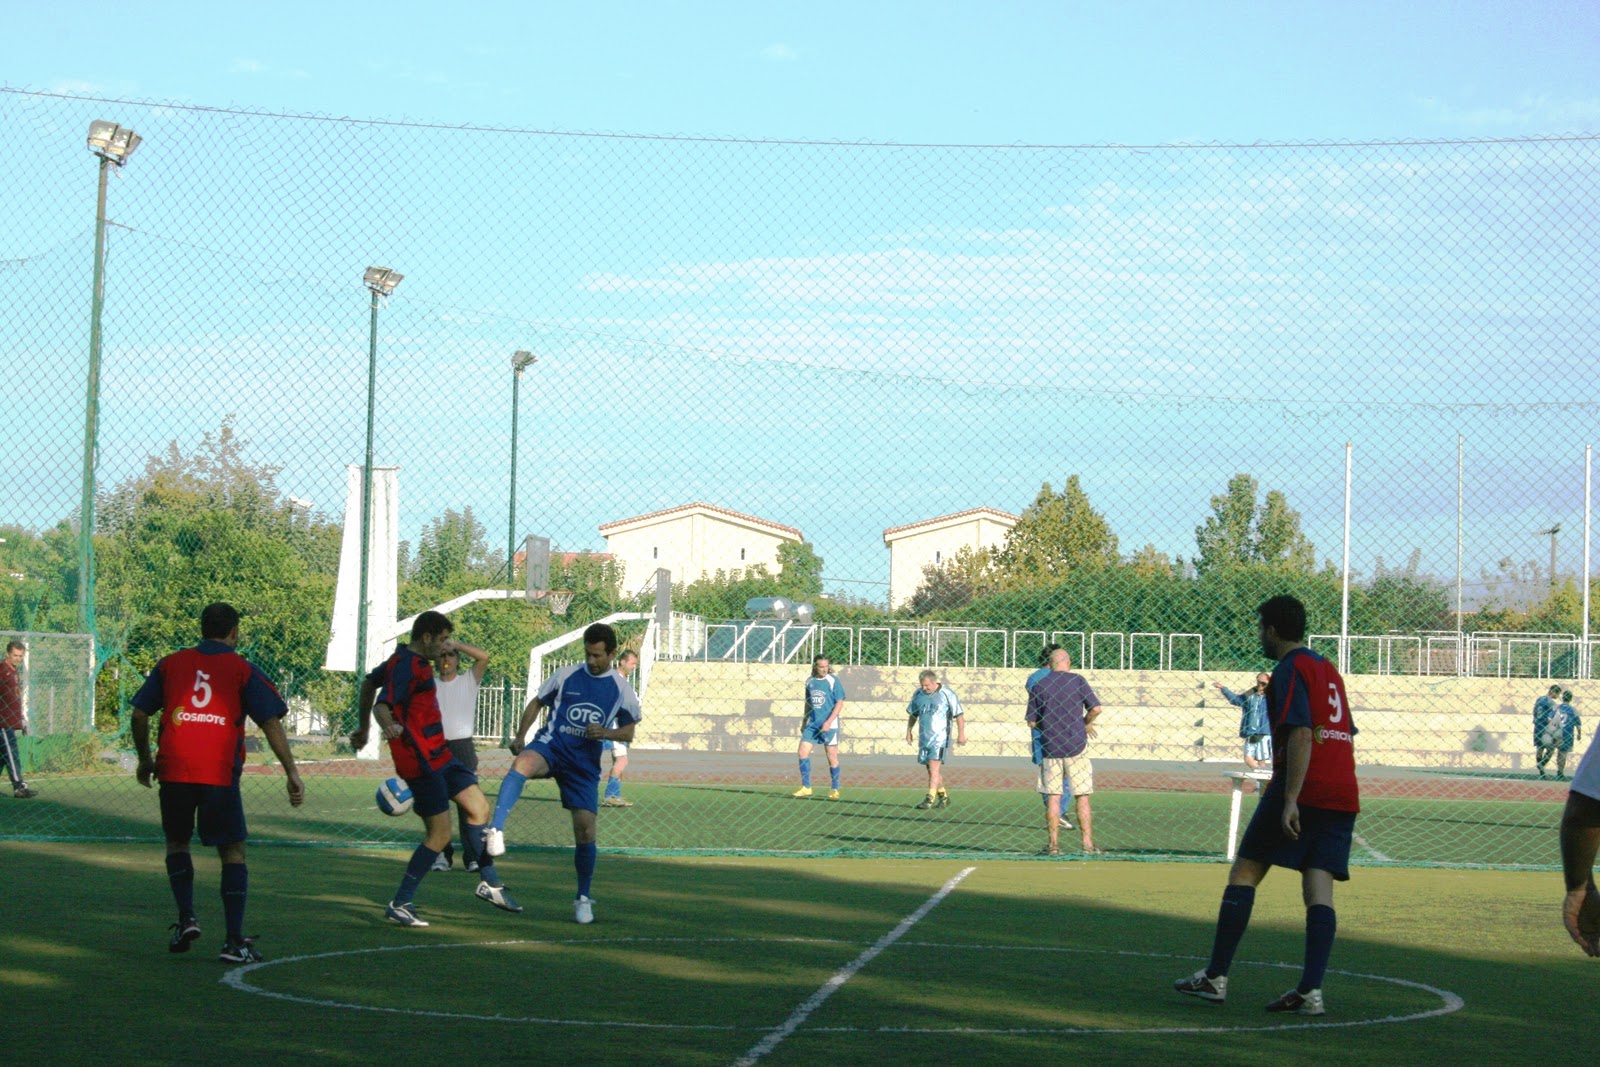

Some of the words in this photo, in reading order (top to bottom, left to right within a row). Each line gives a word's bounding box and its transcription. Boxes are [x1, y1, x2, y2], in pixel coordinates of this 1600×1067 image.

[191, 669, 212, 708] 5
[1328, 682, 1342, 723] 9
[177, 711, 226, 726] COSMOTE
[570, 707, 602, 724] OTE
